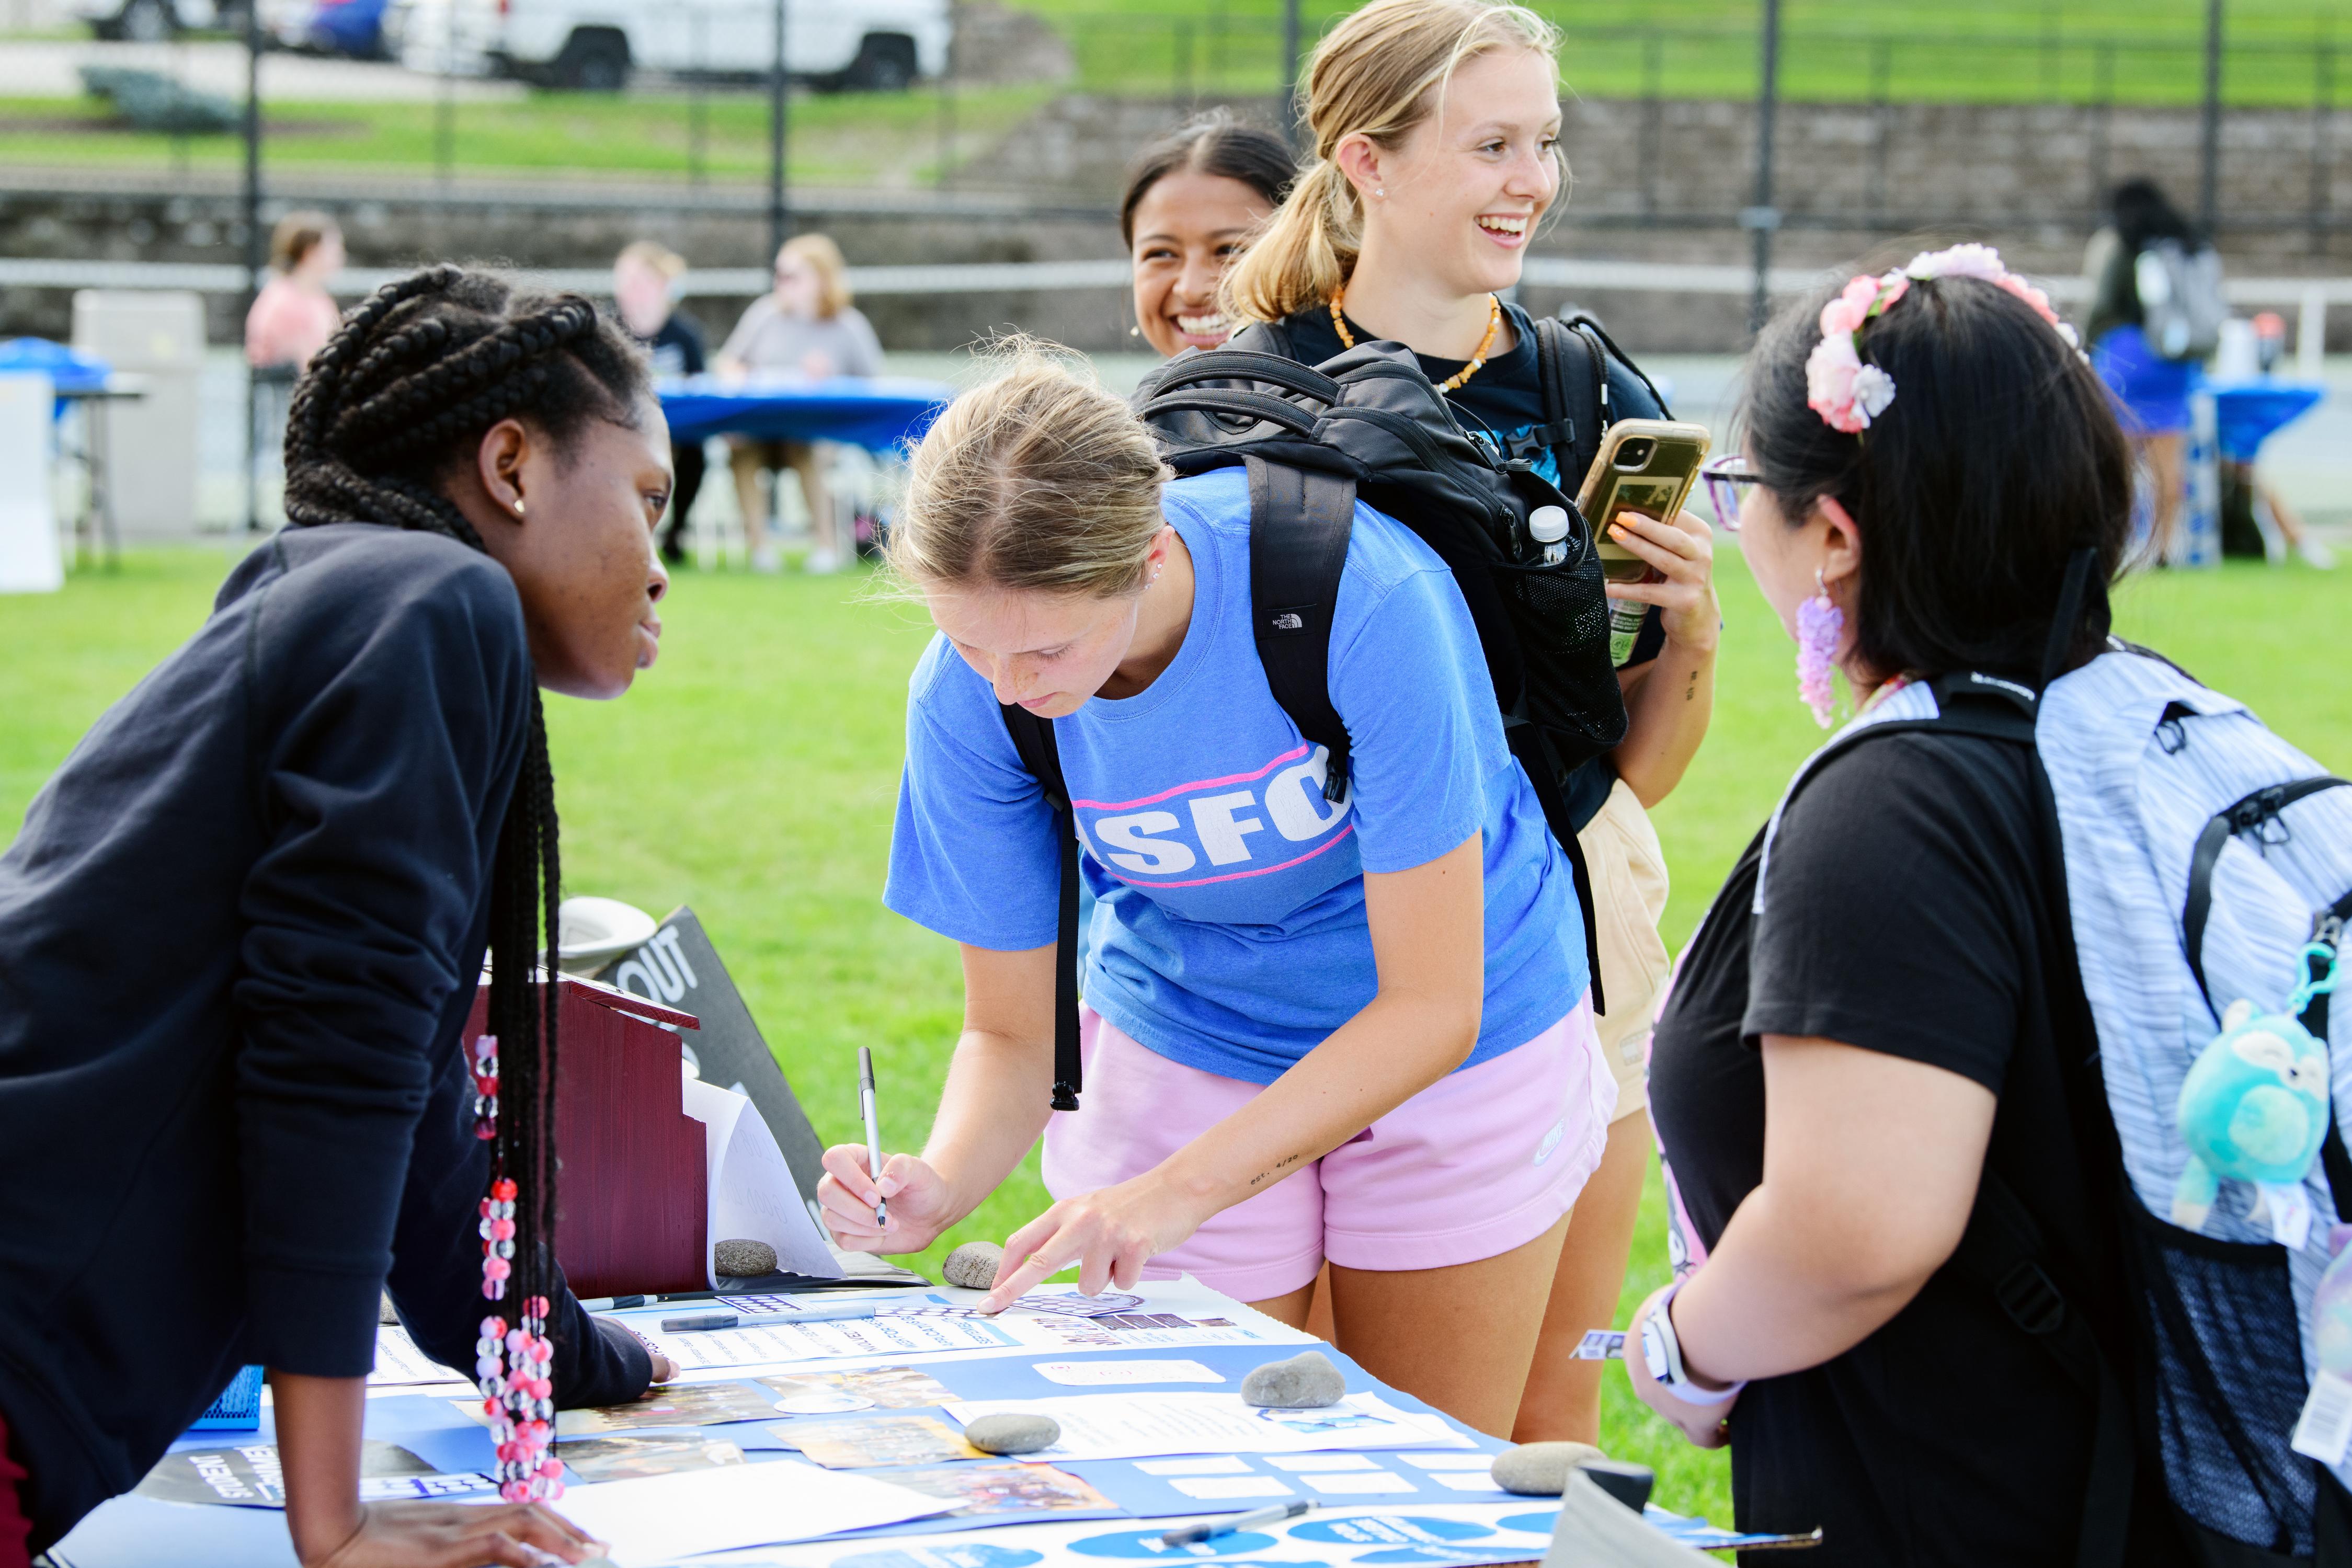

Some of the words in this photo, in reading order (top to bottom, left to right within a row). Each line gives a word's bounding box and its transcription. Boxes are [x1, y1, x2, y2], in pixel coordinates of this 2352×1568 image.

[1074, 745, 1353, 875] SFC
[1250, 1173, 1270, 1185] est.
[1276, 1154, 1298, 1168] 4/20
[788, 1322, 811, 1331] MOR
[881, 1327, 903, 1338] FOR
[188, 1455, 254, 1498] STUDENT
